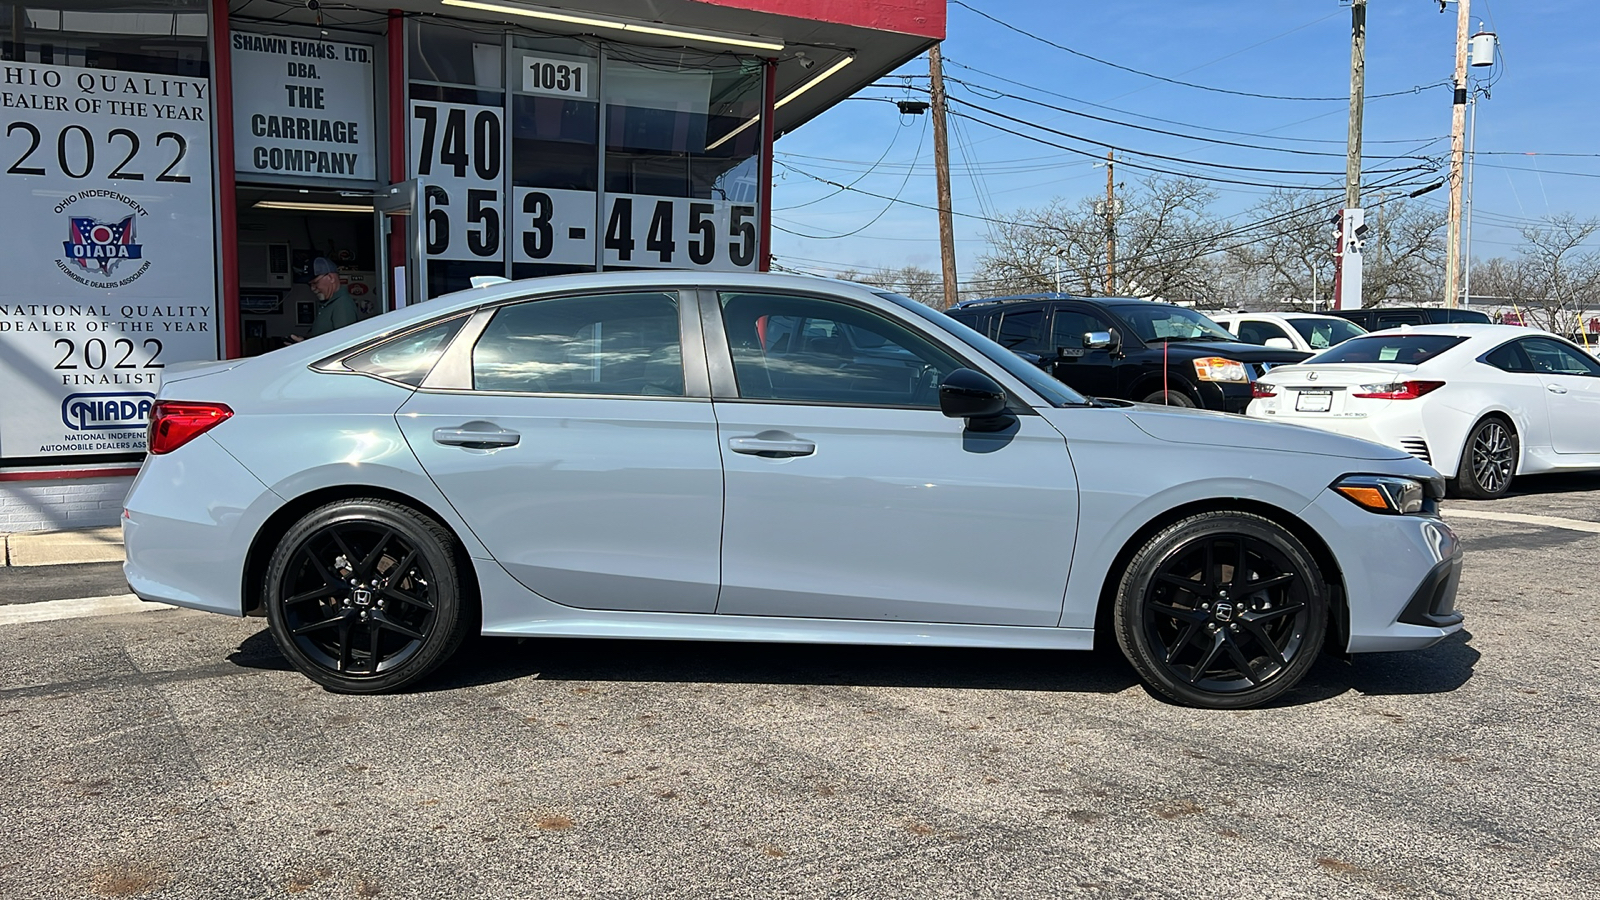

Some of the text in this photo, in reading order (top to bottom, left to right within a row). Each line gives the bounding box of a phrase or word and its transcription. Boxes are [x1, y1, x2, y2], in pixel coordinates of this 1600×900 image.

[233, 33, 287, 54] SHAWN
[344, 46, 371, 64] LTD.
[287, 61, 321, 79] DBA.
[529, 62, 582, 92] 1031
[77, 73, 207, 99] QUALITY
[285, 84, 325, 110] THE
[0, 92, 205, 122] EALER OF THE YEAR
[251, 113, 359, 144] CARRIAGE
[6, 121, 192, 184] 2022
[414, 105, 501, 181] 740
[253, 146, 358, 175] COMPANY
[53, 189, 149, 217] OHIO INDEPENDENT
[73, 245, 129, 257] OIADA
[54, 259, 152, 289] AUTOMOBILE DEALERS ASSOCIATION
[0, 304, 210, 319] NATIONAL QUALITY
[0, 321, 209, 332] DEALER OF THE YEAR
[54, 338, 165, 370] 2022
[62, 373, 156, 385] FINALIST
[70, 399, 152, 421] NIADA
[40, 443, 94, 452] AUTOMOBILE
[96, 442, 130, 451] DEALERS
[64, 432, 106, 441] NATIONAL
